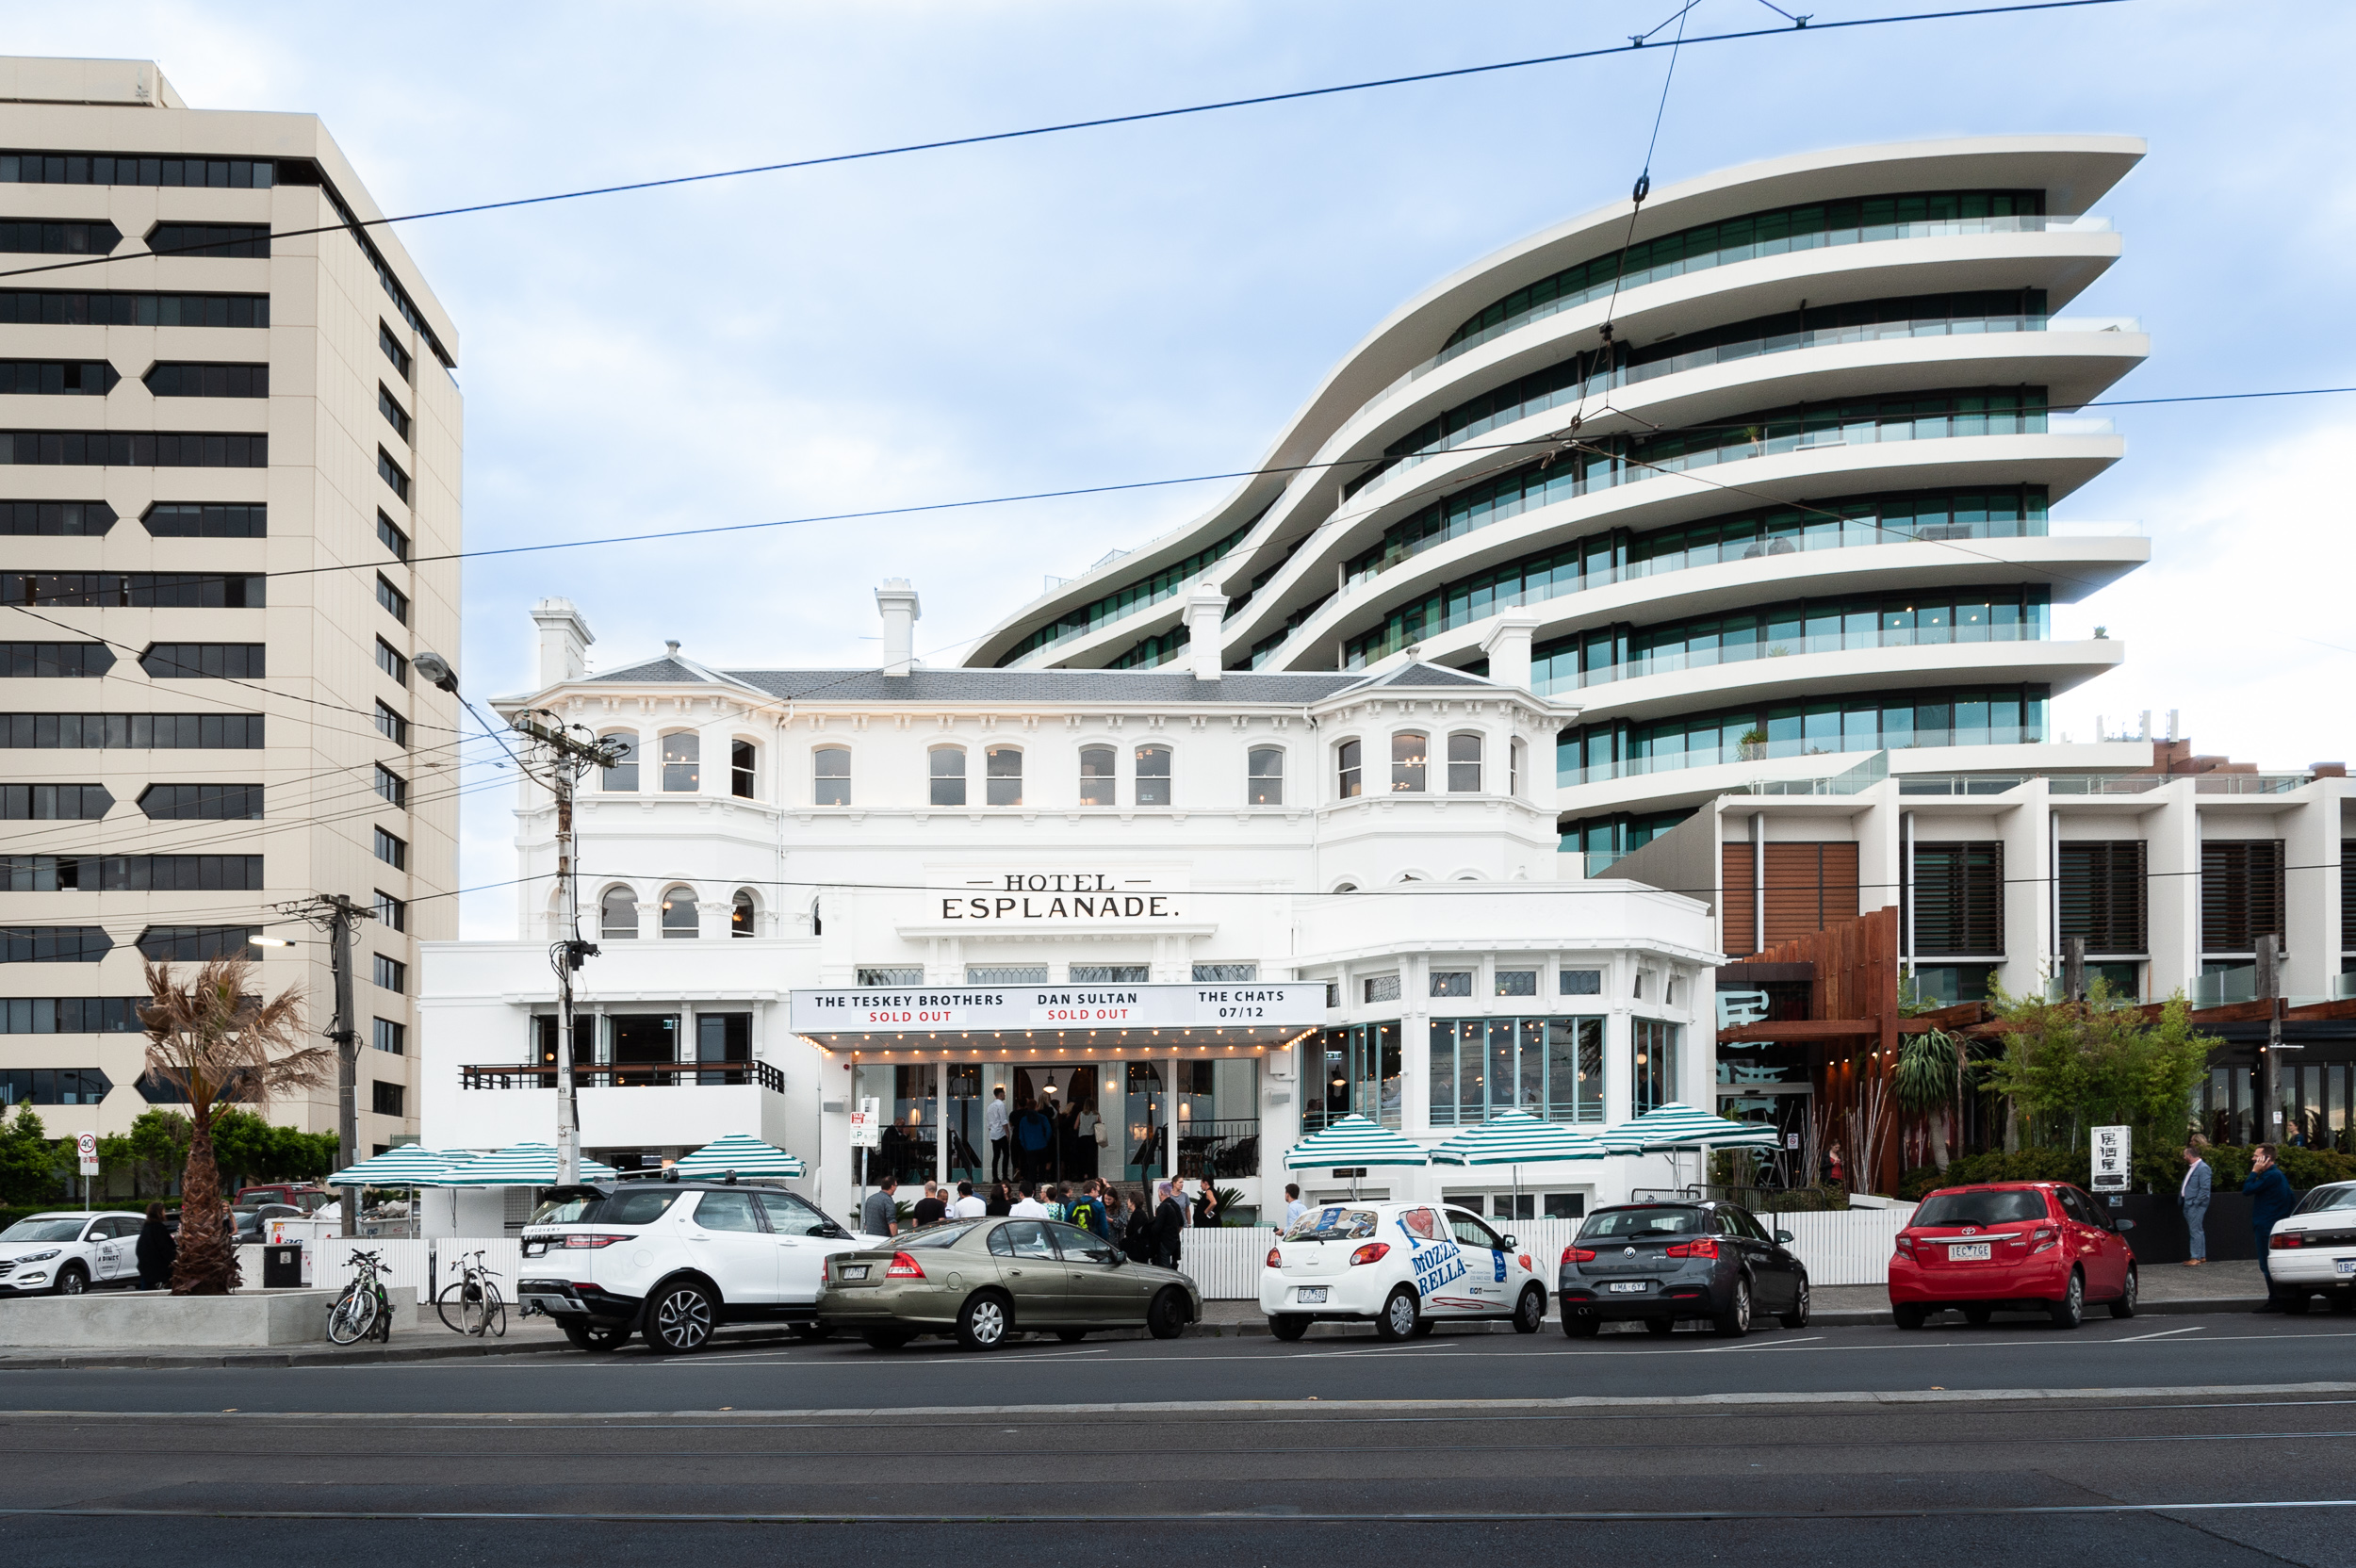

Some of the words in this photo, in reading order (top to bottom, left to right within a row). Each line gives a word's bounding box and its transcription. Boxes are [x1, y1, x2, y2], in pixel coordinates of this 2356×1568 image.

[1004, 874, 1115, 892] HOTEL
[942, 896, 1180, 919] ESPLANADE.
[815, 996, 845, 1007] THE
[852, 995, 912, 1007] TESKEY
[919, 994, 1004, 1006] BROTHERS
[1038, 993, 1071, 1004] DAN
[1077, 992, 1137, 1004] SULTAN
[1199, 991, 1228, 1003] THE
[1235, 990, 1284, 1002] CHATS
[870, 1011, 911, 1022] SOLD
[919, 1011, 951, 1021] OUT
[1048, 1009, 1089, 1021] SOLD
[1096, 1008, 1128, 1020] OUT
[1219, 1006, 1264, 1018] 07/12
[81, 1138, 93, 1149] 40
[1973, 1245, 1988, 1255] 7GE
[1411, 1238, 1461, 1276] MOZZA
[1417, 1257, 1467, 1298] RELLA
